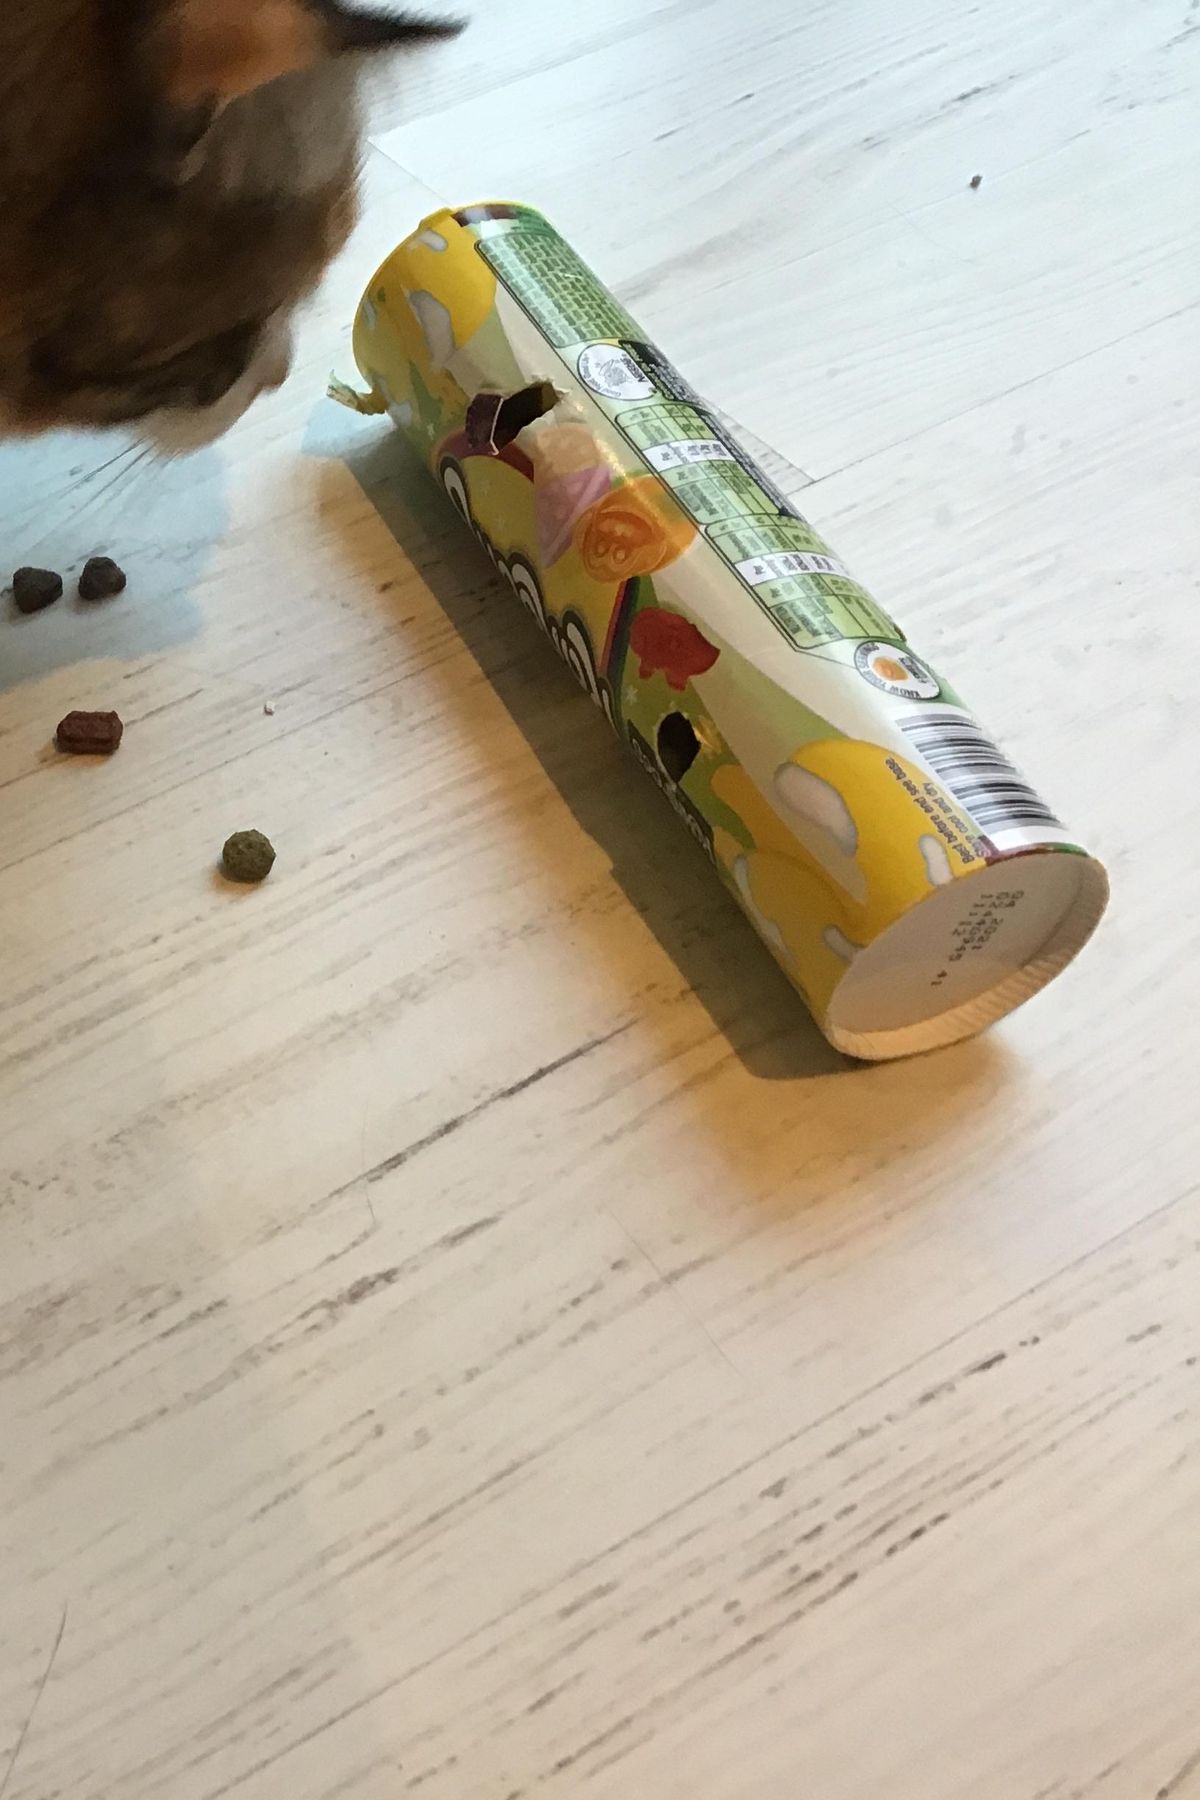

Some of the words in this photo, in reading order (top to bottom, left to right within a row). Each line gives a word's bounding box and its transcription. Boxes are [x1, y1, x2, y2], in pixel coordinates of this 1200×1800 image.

[885, 758, 906, 781] base
[902, 780, 919, 796] see
[922, 782, 938, 797] dry
[913, 796, 934, 814] end
[932, 797, 953, 814] and
[930, 814, 958, 844] before
[947, 815, 969, 834] cool
[952, 843, 975, 864] Best
